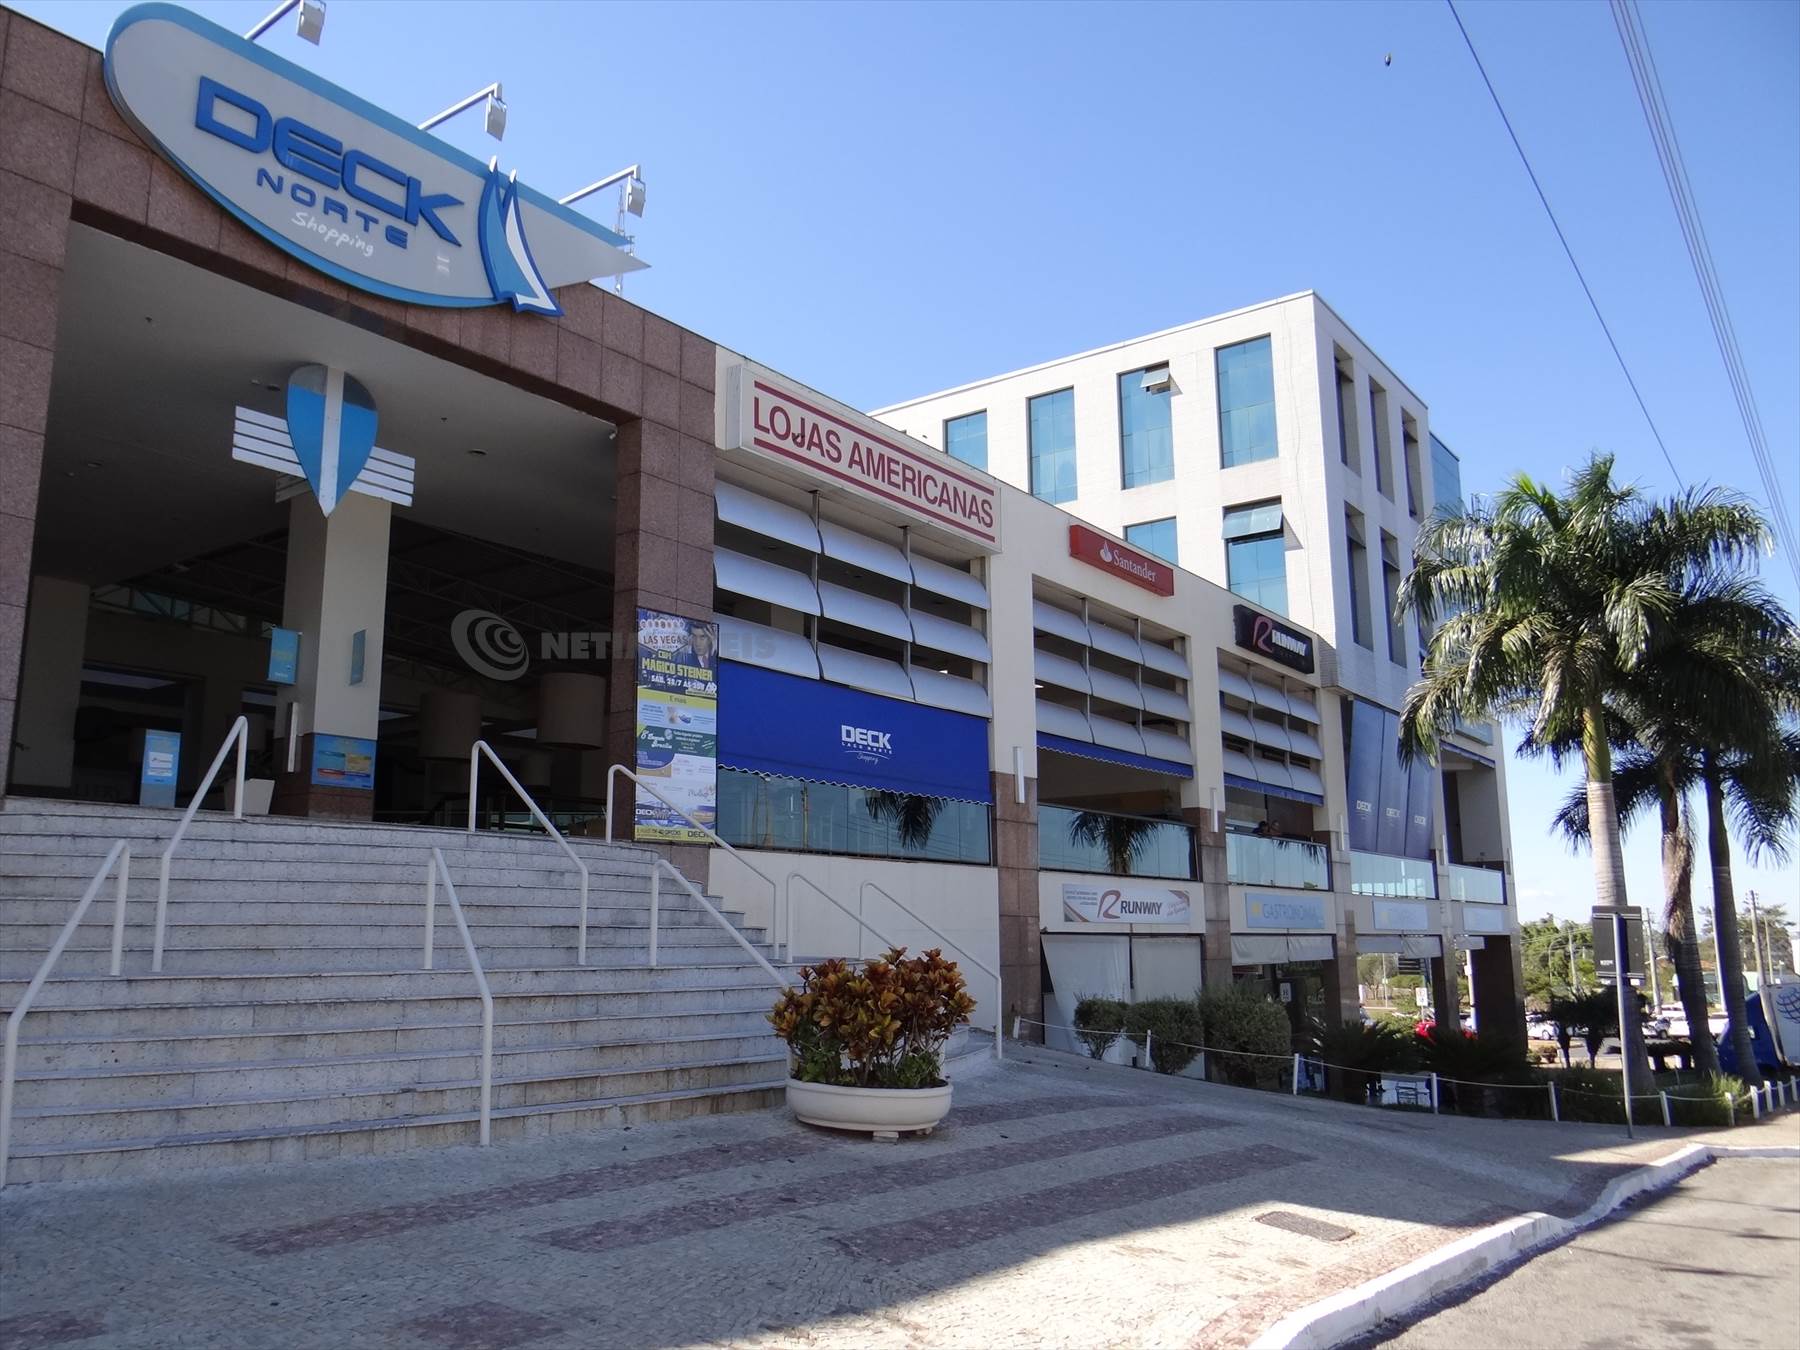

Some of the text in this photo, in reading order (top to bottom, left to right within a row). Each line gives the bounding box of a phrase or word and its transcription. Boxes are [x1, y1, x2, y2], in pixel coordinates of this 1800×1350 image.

[196, 75, 464, 247] DECK
[257, 168, 408, 249] NORTE
[291, 211, 374, 256] Shopping
[754, 397, 993, 528] LOJAS AMERICANAS
[1113, 550, 1156, 582] Santander
[643, 635, 688, 645] LAS VEGAS
[841, 725, 892, 750] DECK
[1120, 900, 1163, 915] RUNWAY
